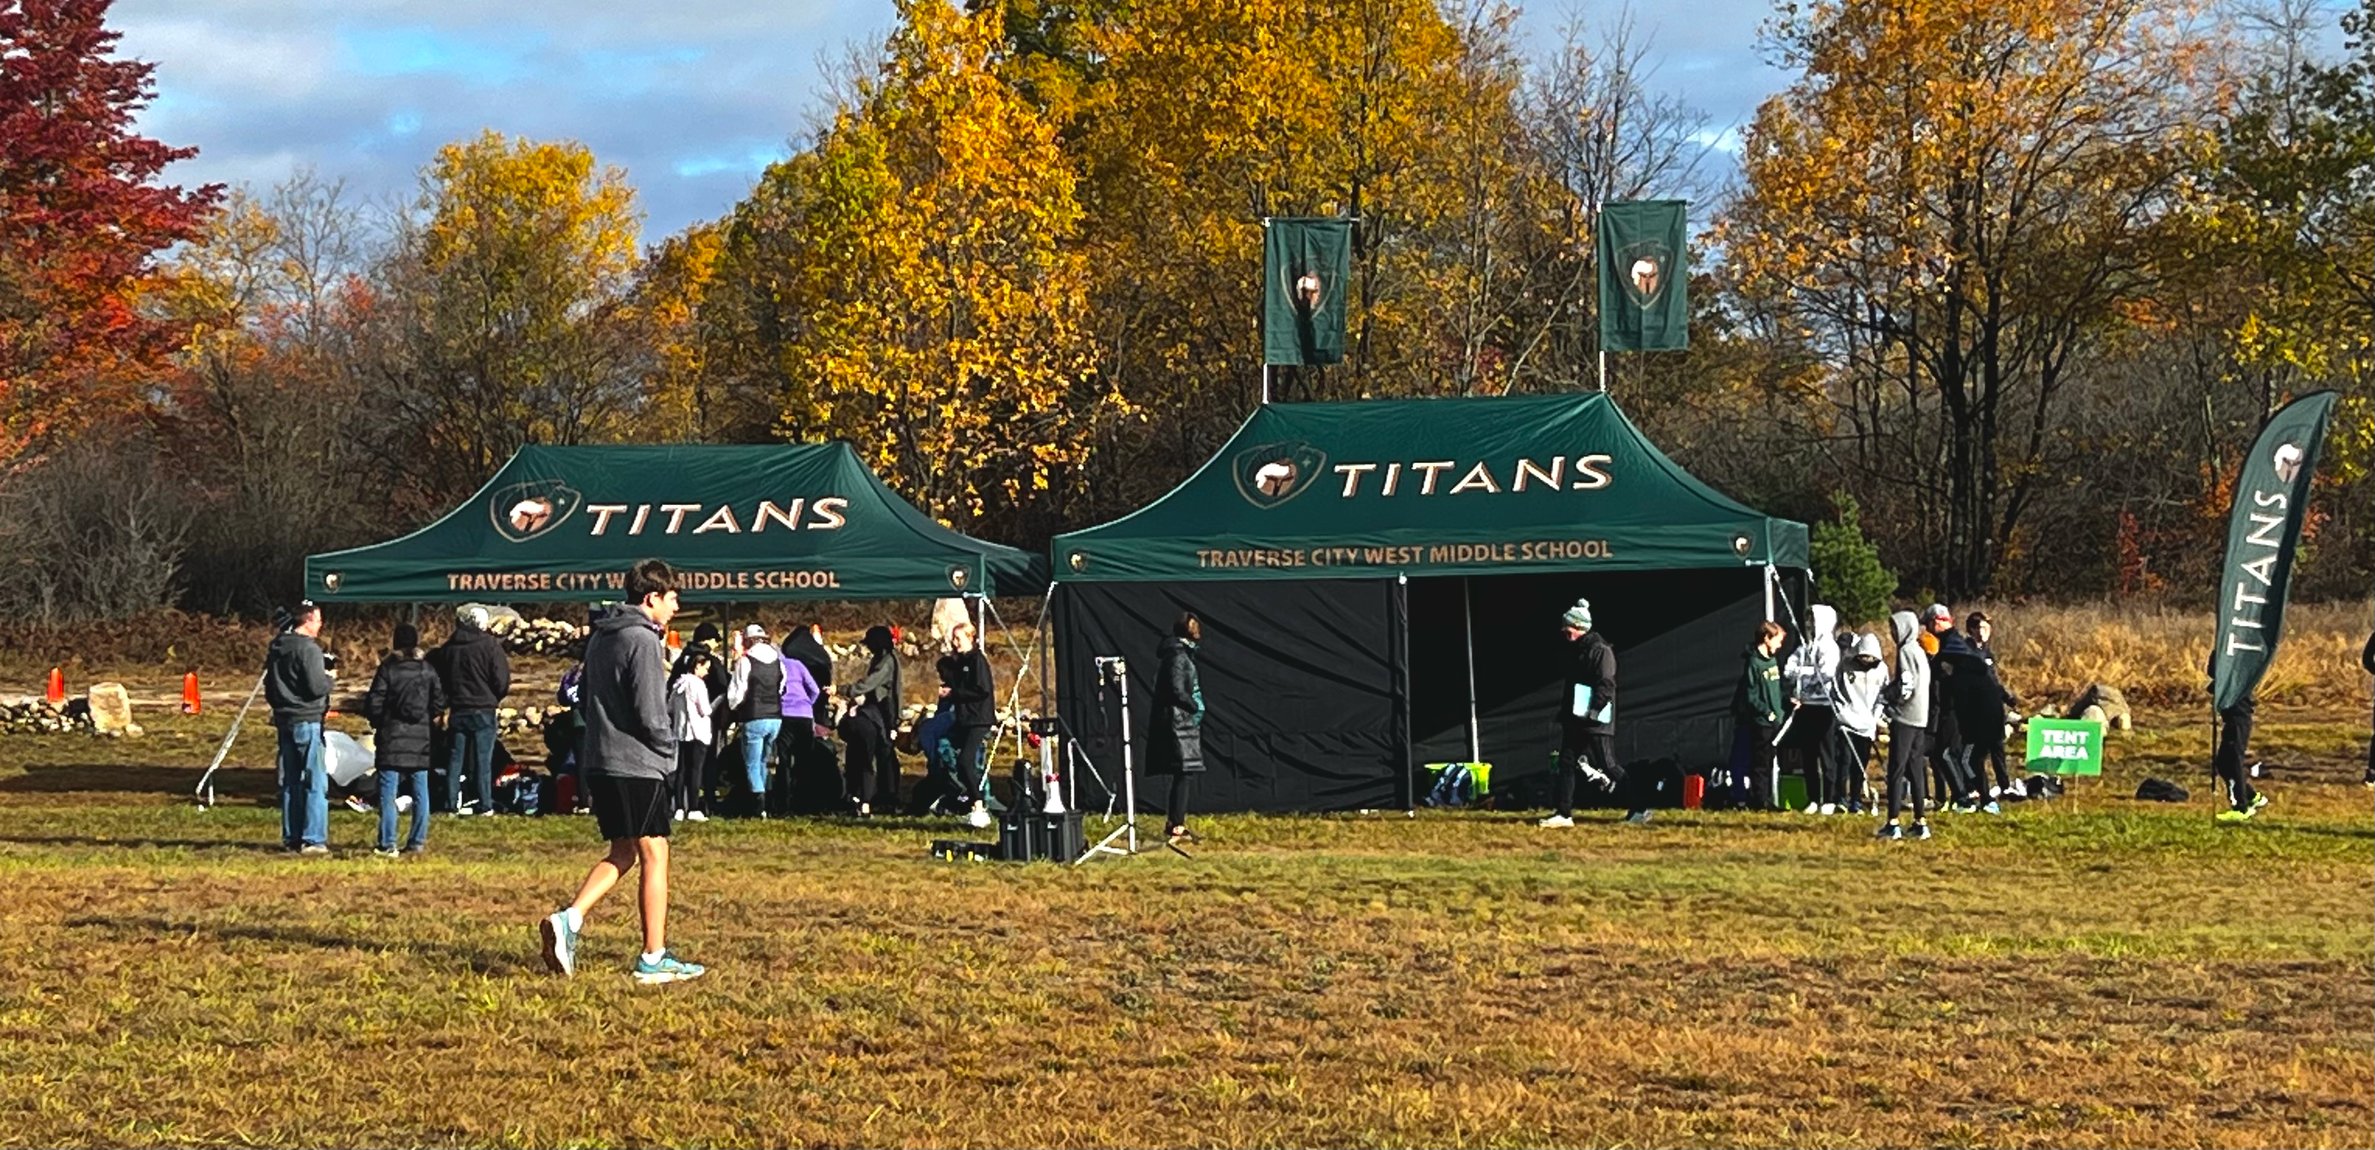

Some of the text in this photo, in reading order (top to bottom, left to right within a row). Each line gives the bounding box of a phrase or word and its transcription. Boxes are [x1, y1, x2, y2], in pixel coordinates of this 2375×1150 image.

[1334, 454, 1613, 498] TITANS
[586, 497, 848, 536] TITANS
[1197, 540, 1614, 568] TRAVERSE CITY WEST MIDDLE SCHOOL
[447, 572, 550, 591] TRAVERSE
[556, 572, 602, 590] CITY
[753, 570, 840, 590] SCHOOL
[2226, 490, 2288, 656] TITANS
[2041, 729, 2090, 745] TENT
[2039, 745, 2090, 760] AREA
